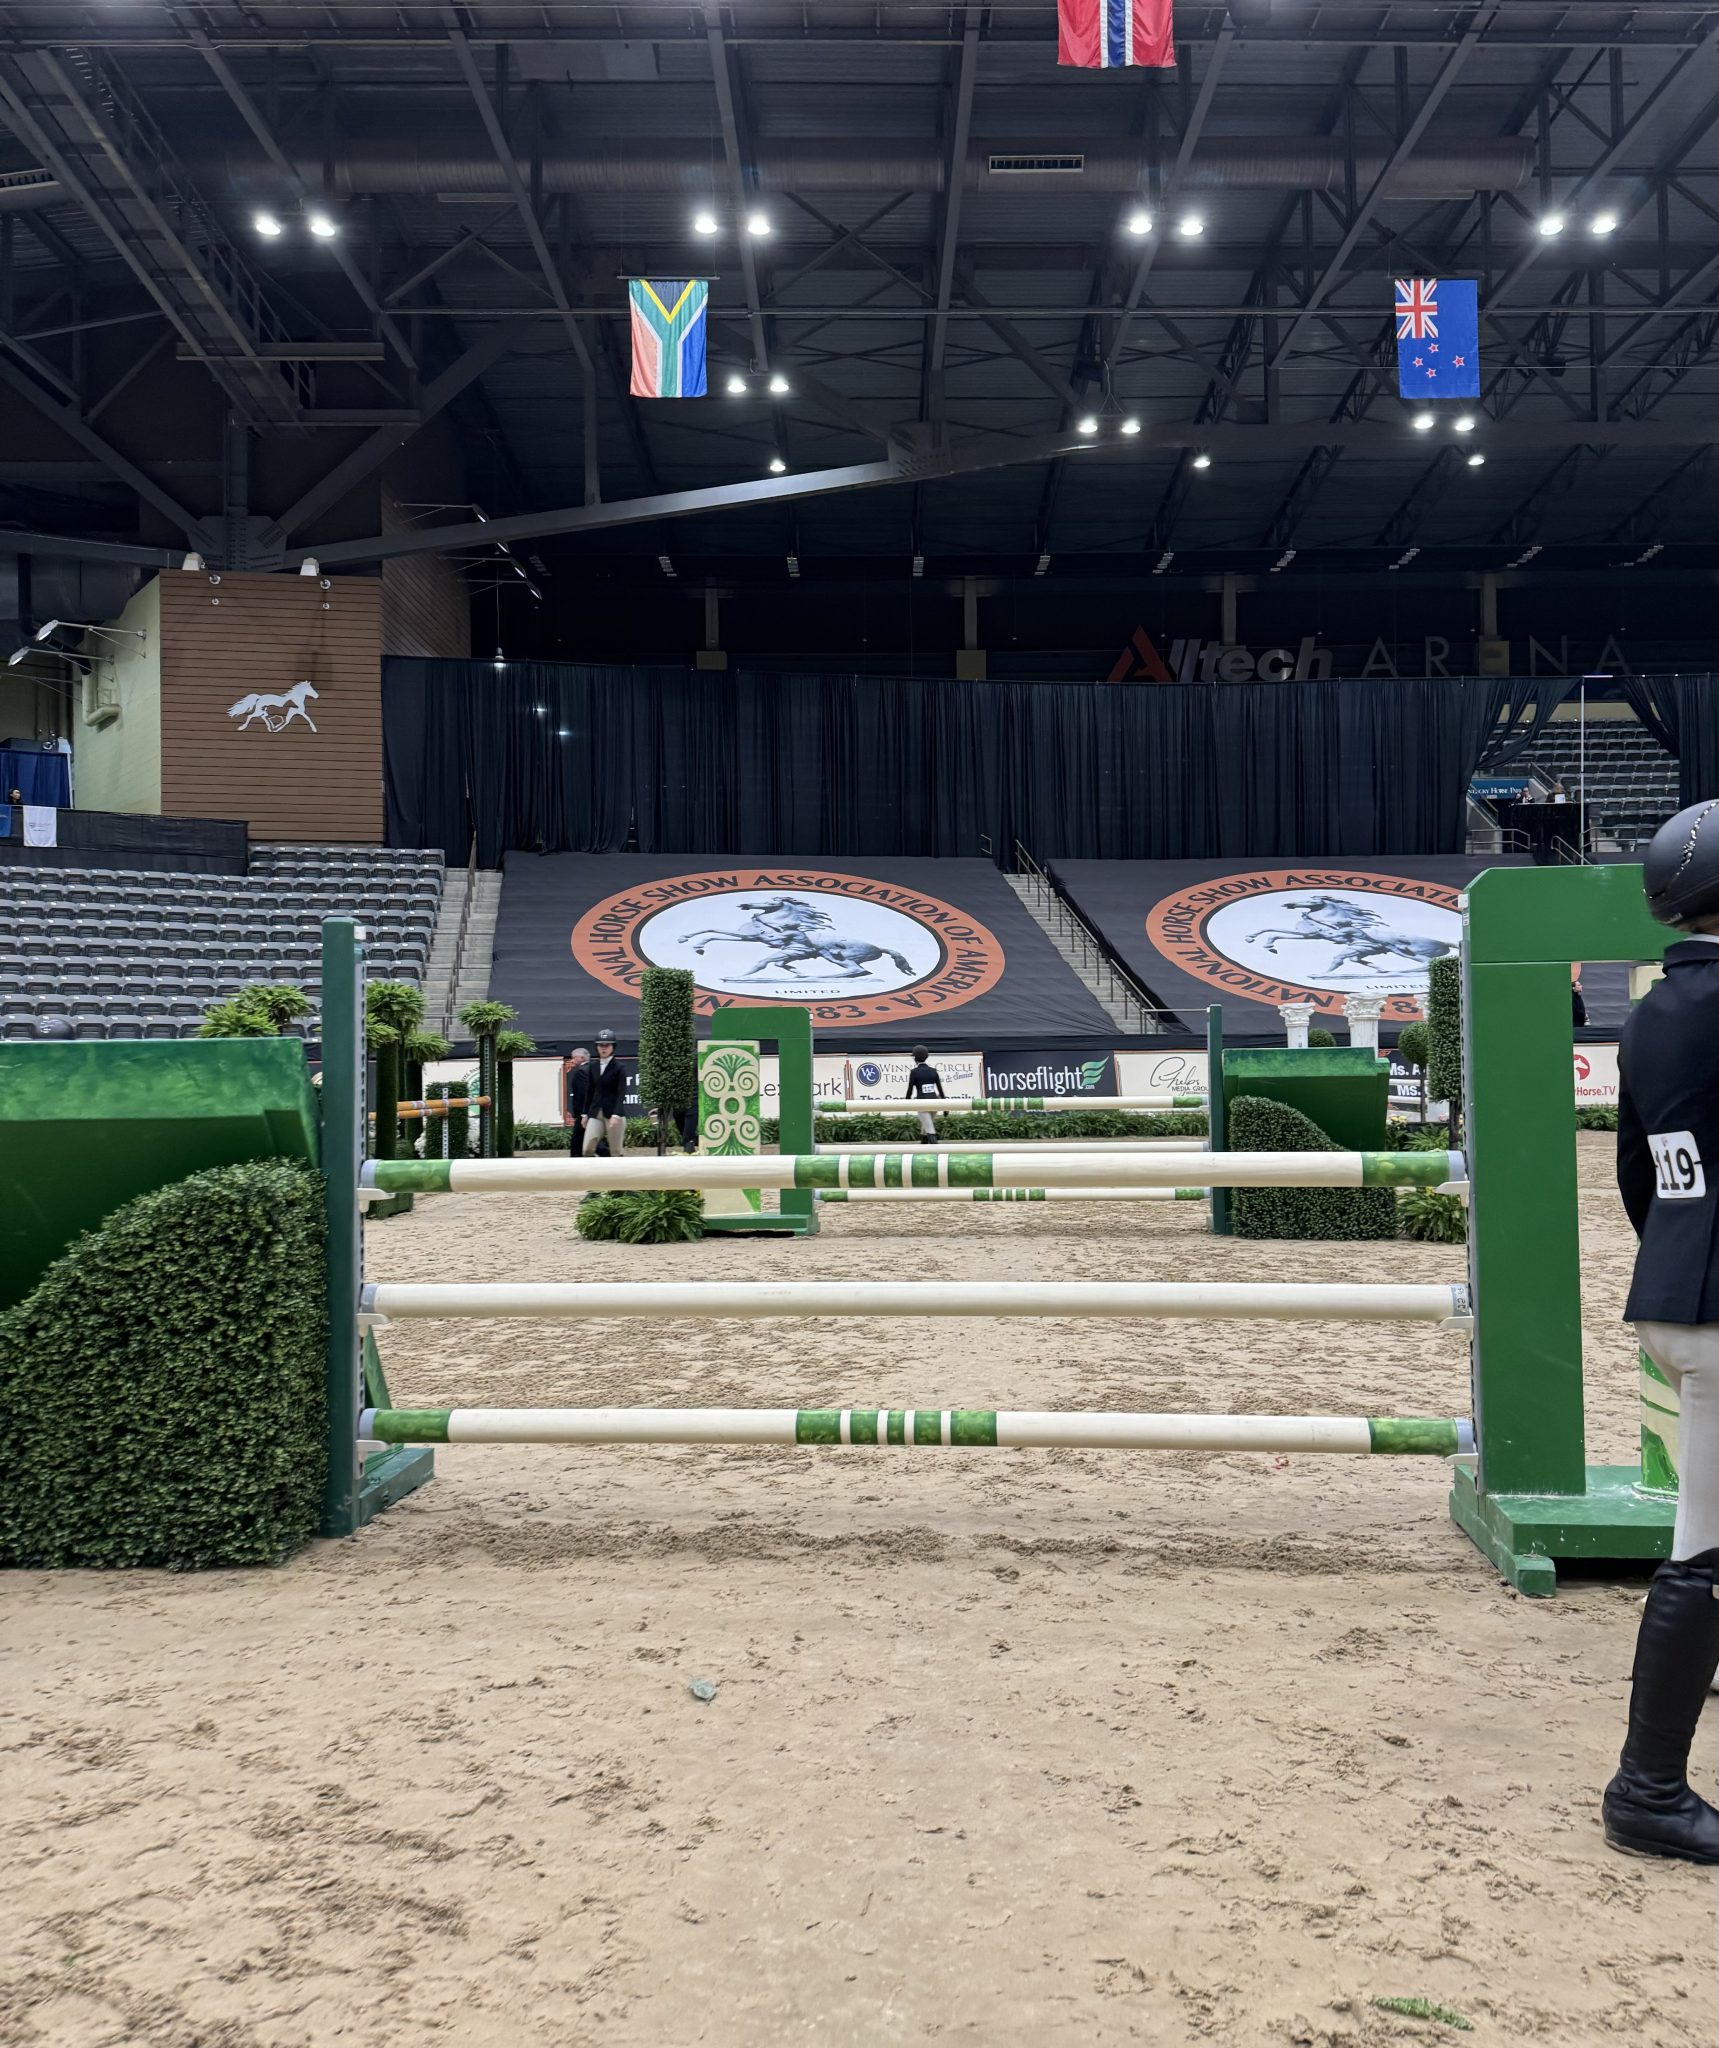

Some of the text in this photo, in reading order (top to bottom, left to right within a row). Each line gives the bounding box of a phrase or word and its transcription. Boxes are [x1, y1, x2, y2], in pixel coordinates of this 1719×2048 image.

[1107, 624, 1631, 683] Alltech ARNA
[641, 875, 739, 902] SHOW
[753, 874, 957, 925] ASSOCIATION
[589, 898, 654, 944] HORSE
[943, 925, 984, 945] OF
[1161, 874, 1458, 1008] NATIONAL HORSE SHOW ASSOCIATI
[890, 947, 989, 1009] AMERICA
[811, 1005, 866, 1020] 83
[935, 1062, 973, 1073] CIRCLE
[987, 1066, 1083, 1095] horseflight
[1397, 1085, 1421, 1096] MS.
[1574, 1085, 1616, 1096] Horse.TV
[1655, 1147, 1696, 1190] 119
